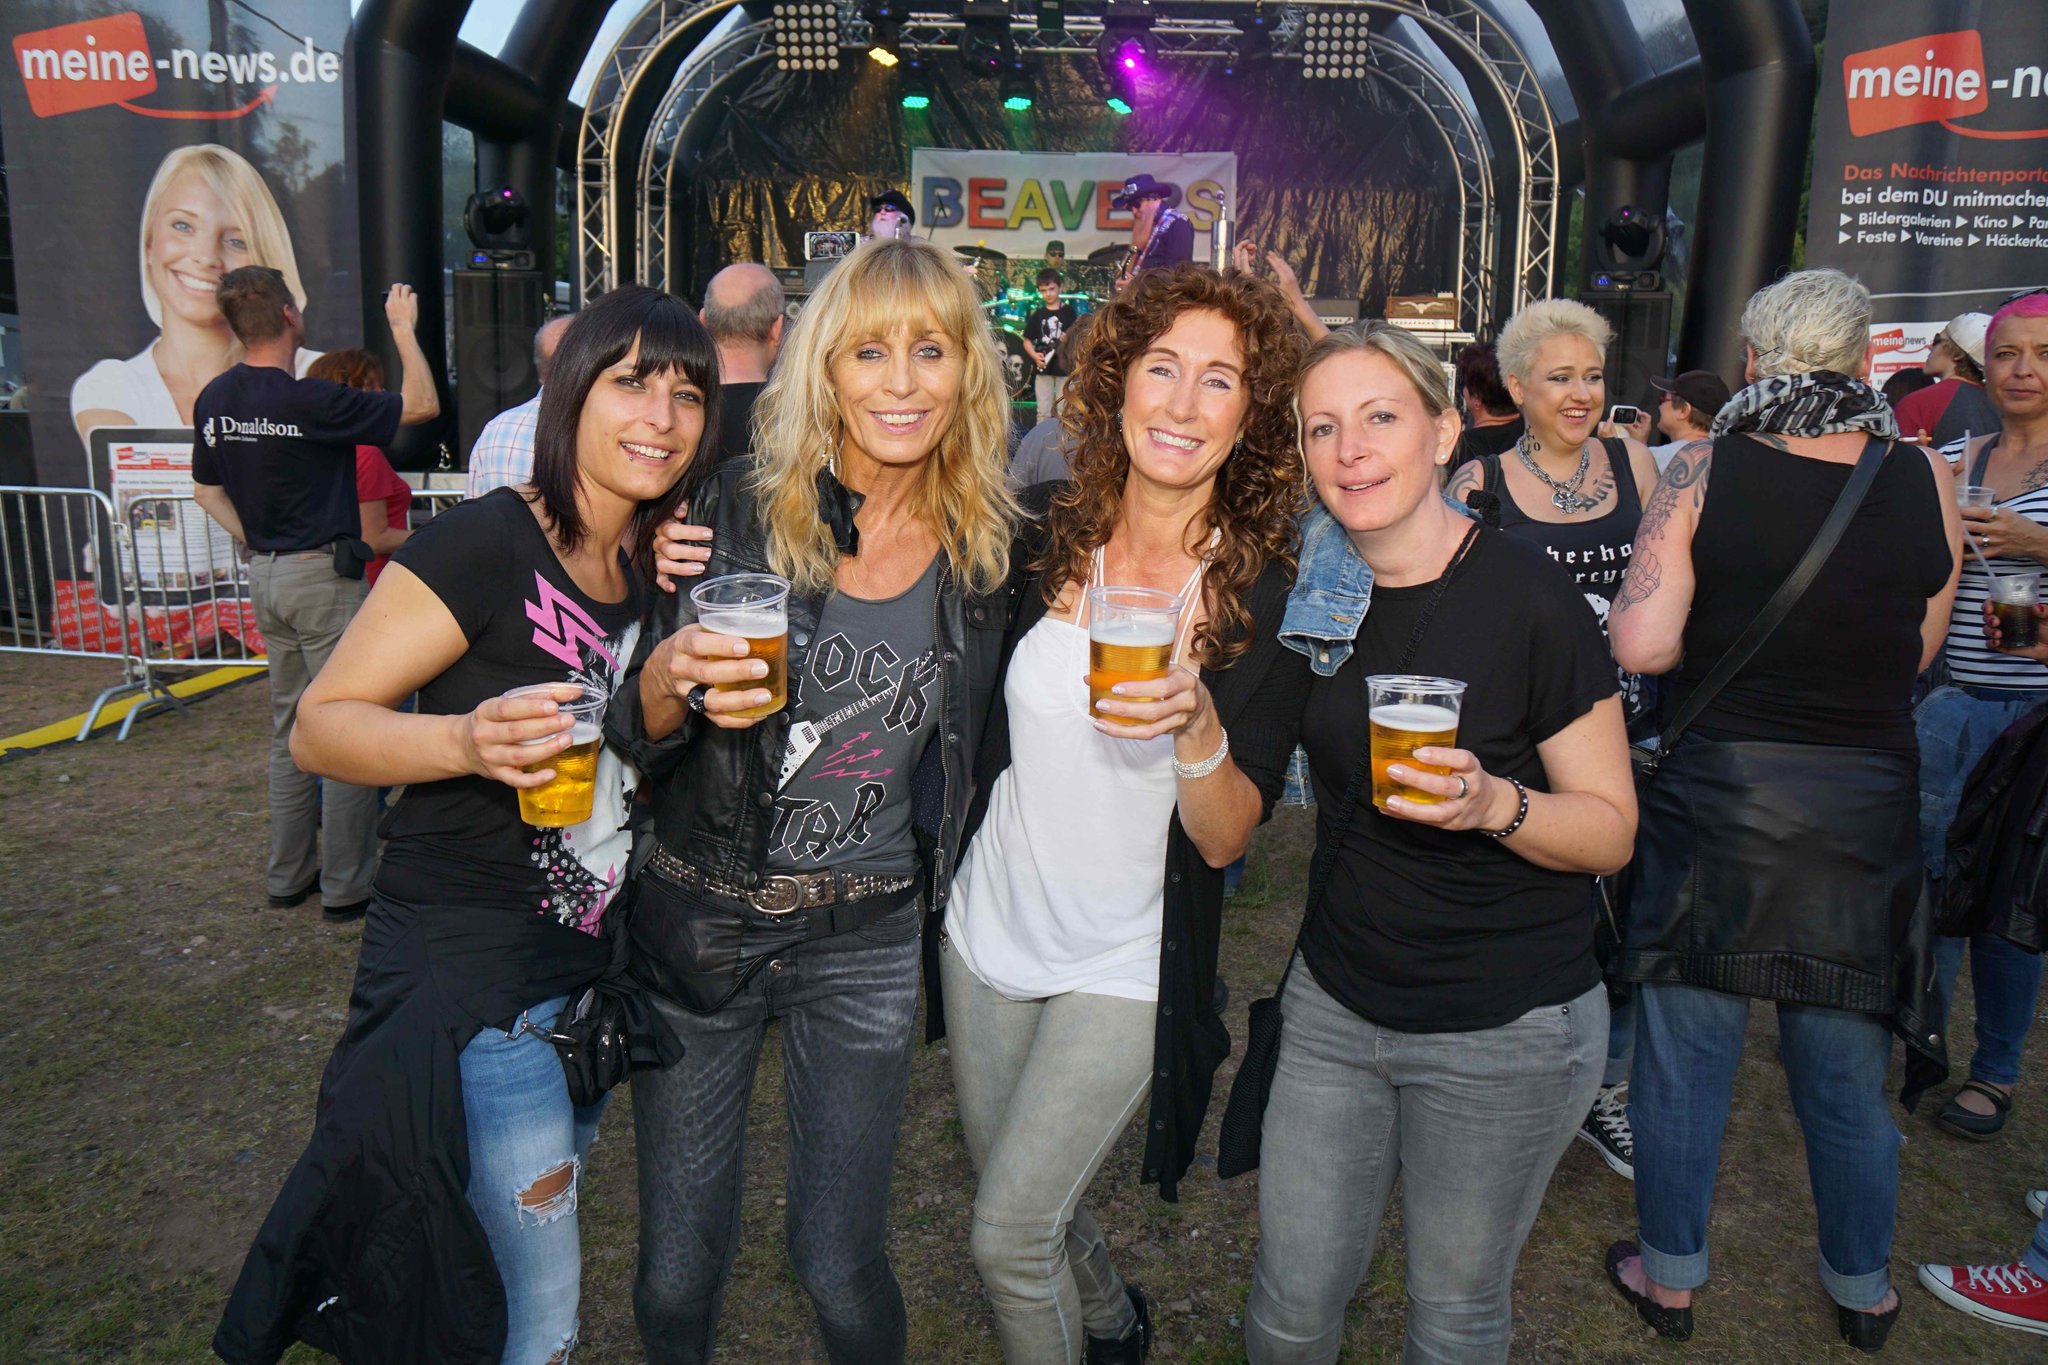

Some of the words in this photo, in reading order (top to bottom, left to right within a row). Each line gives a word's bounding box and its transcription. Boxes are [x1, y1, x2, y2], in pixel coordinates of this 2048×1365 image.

[22, 35, 340, 84] meine-news.de
[1849, 49, 2048, 101] meine-n
[1844, 164, 1882, 181] Das
[922, 175, 1225, 231] BEAVES
[1841, 187, 1871, 205] bei
[1878, 186, 1918, 204] dem
[1923, 189, 1948, 206] DU
[1858, 211, 1951, 229] Bildergalerien
[1973, 214, 2008, 228] Kino
[1857, 230, 1896, 244] Feste
[1915, 232, 1963, 247] Vereine
[796, 632, 938, 736] OCK
